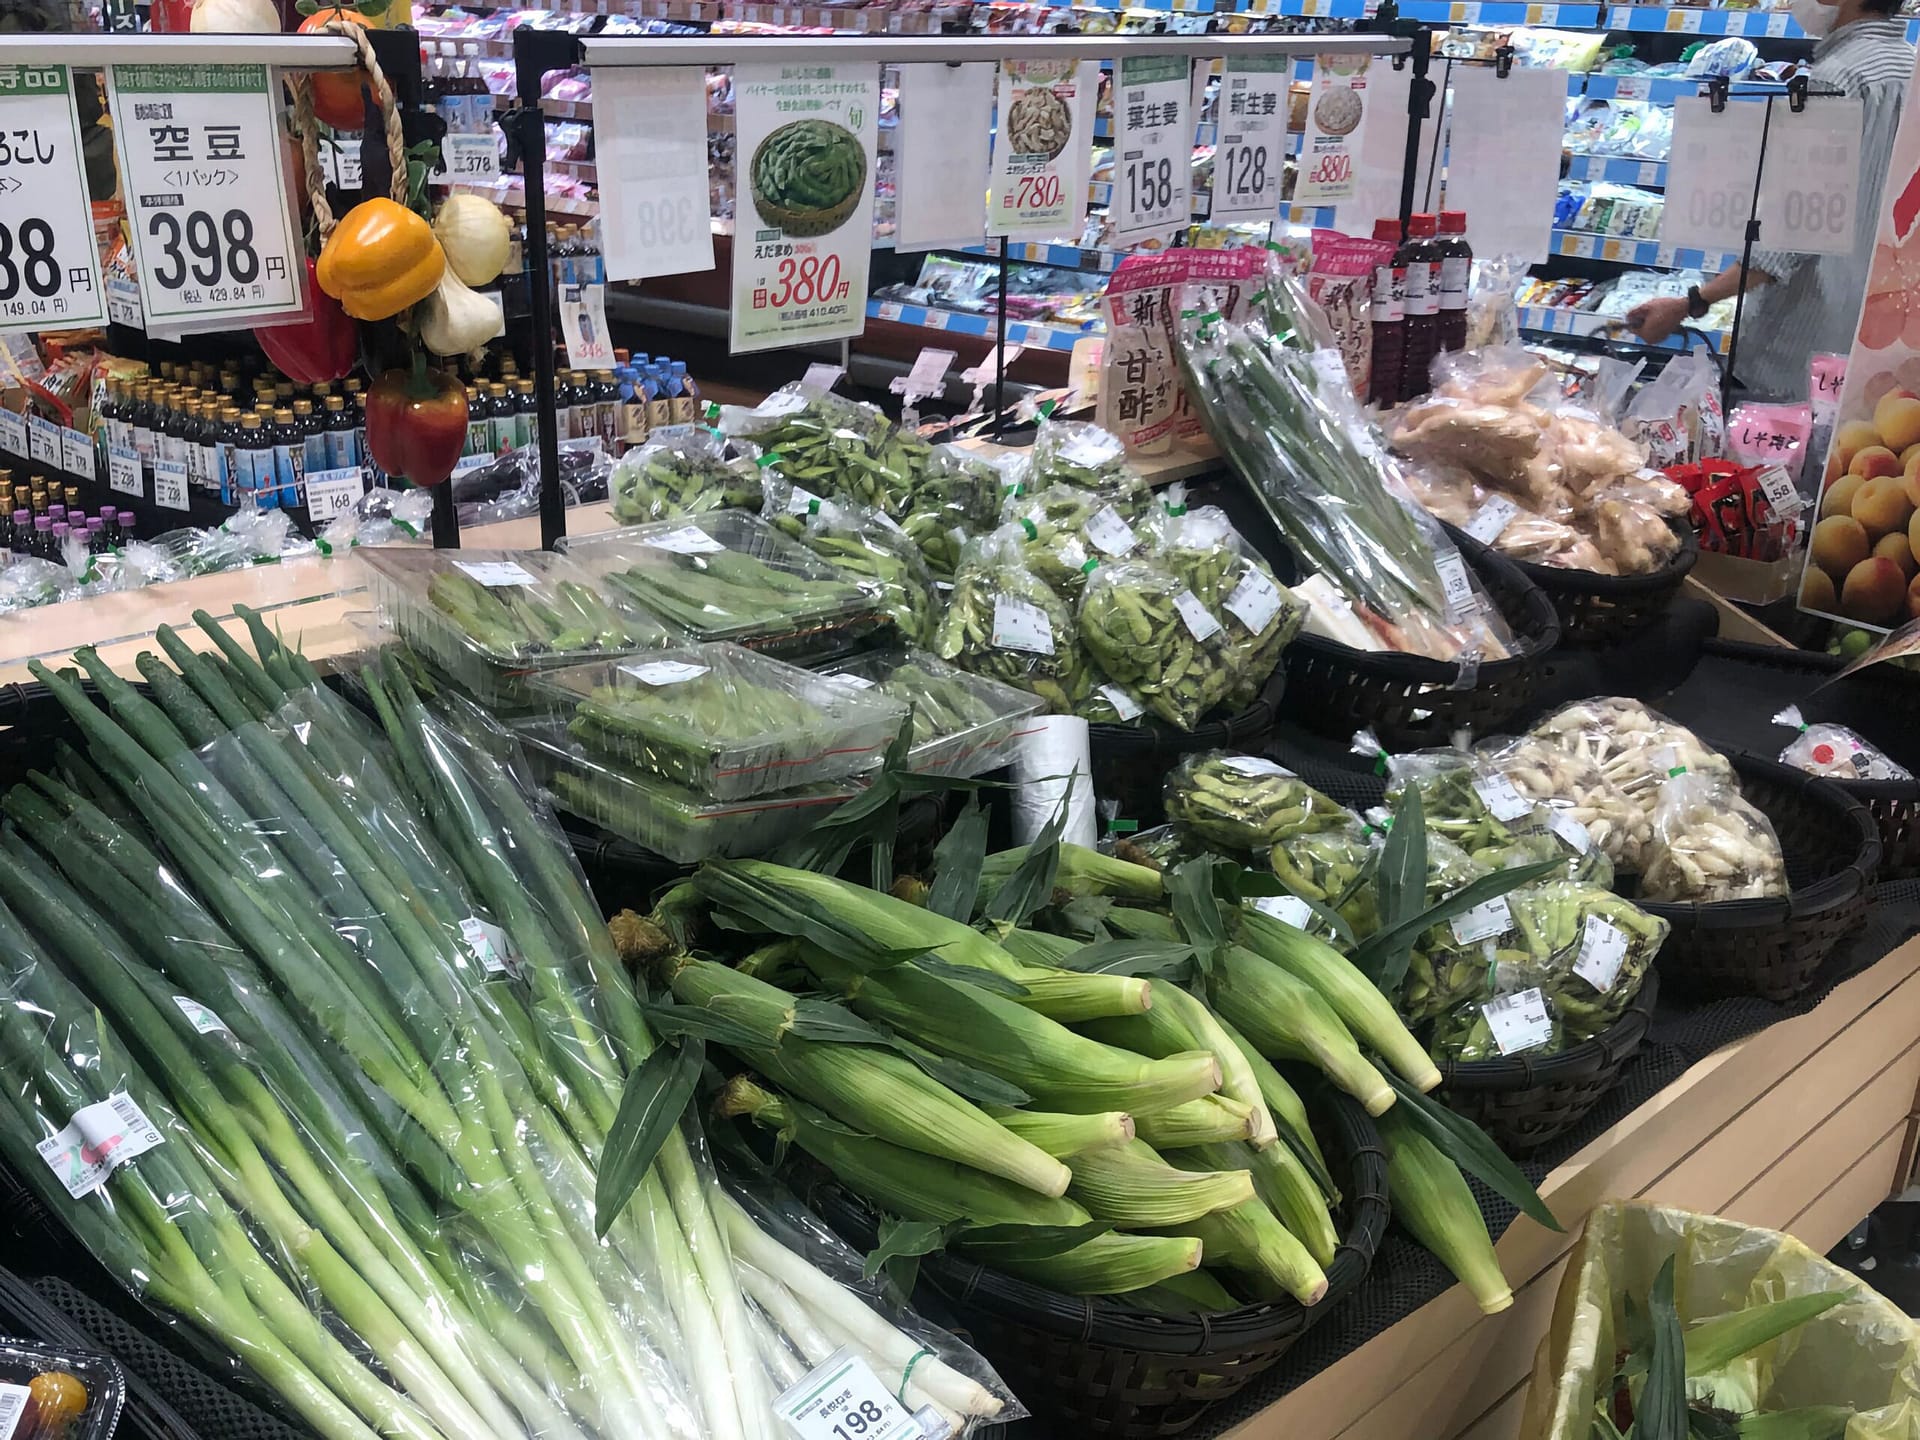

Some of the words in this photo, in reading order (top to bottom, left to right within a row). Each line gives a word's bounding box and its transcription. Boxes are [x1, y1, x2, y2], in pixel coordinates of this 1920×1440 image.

[1127, 101, 1178, 131] 葉生姜
[1230, 92, 1277, 115] 新生姜
[150, 125, 245, 162] 空豆
[754, 243, 793, 259] えだまめ
[1117, 349, 1153, 425] 甘酢
[329, 493, 350, 509] 168
